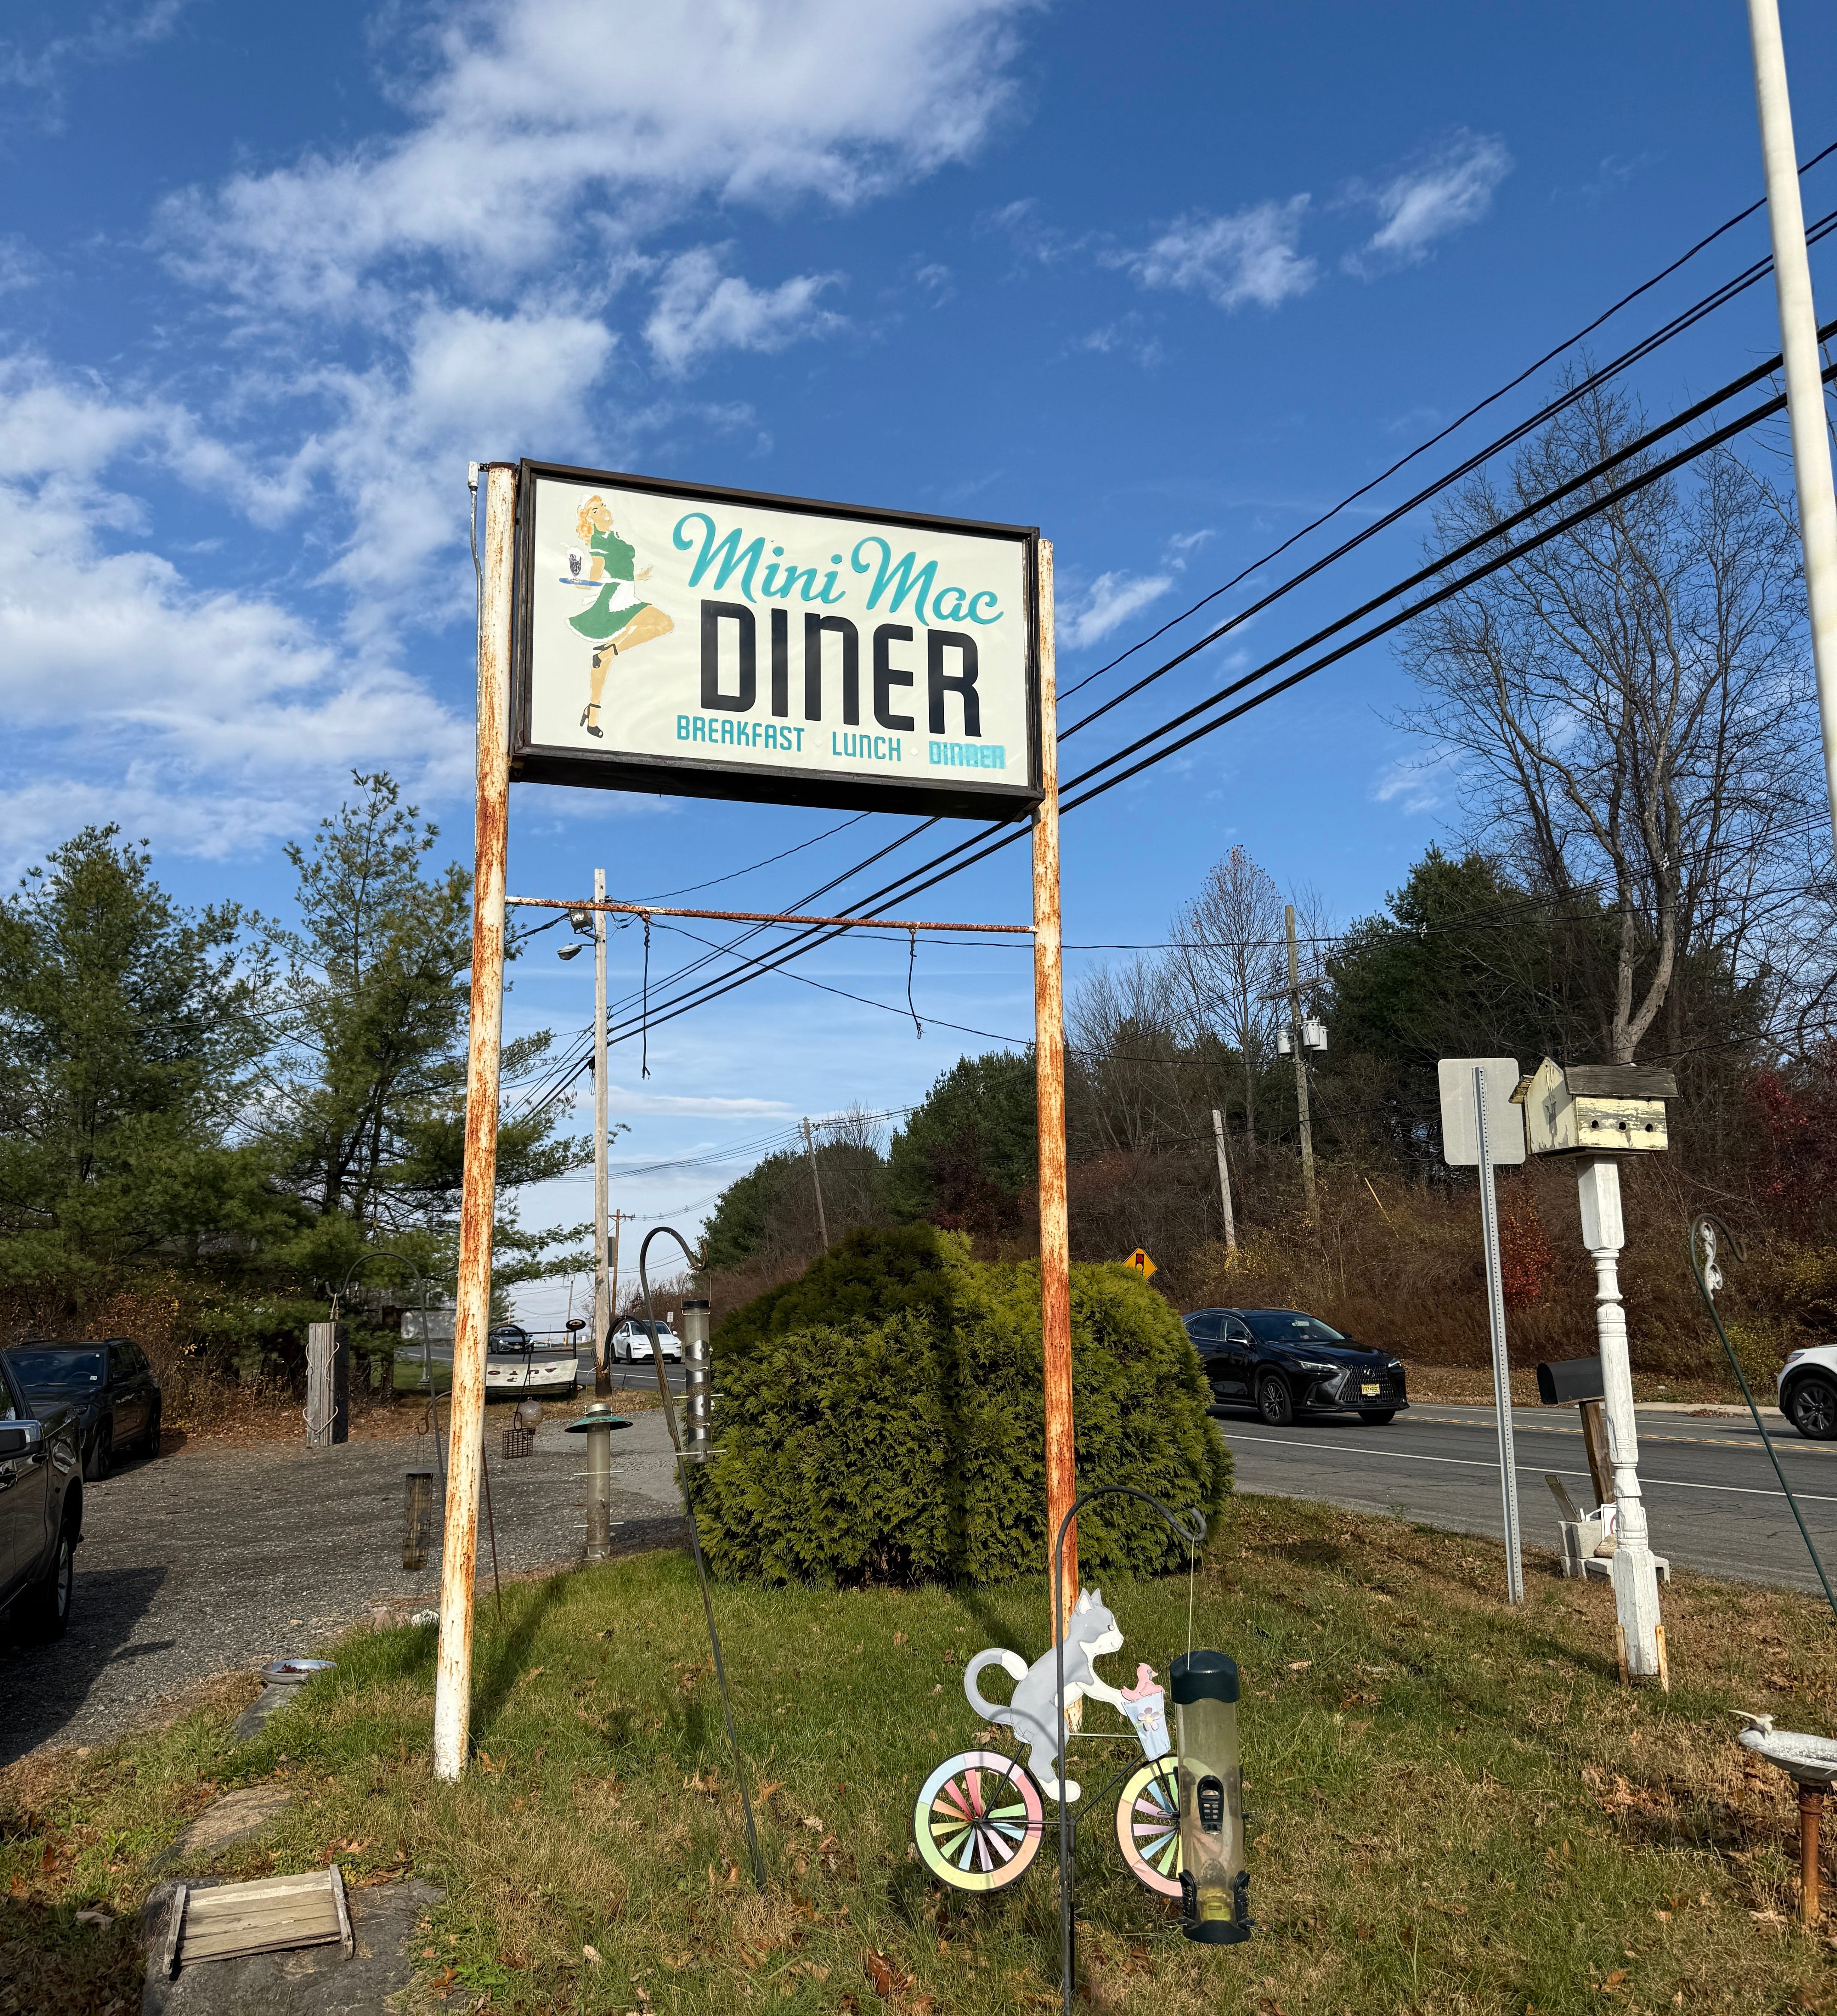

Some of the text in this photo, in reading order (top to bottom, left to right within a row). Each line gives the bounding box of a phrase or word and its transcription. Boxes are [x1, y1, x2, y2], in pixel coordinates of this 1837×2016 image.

[672, 513, 1004, 626] Mini Mac
[701, 599, 982, 737] DINER
[677, 715, 804, 752] BREAKFAST
[832, 731, 901, 762] LUNCH
